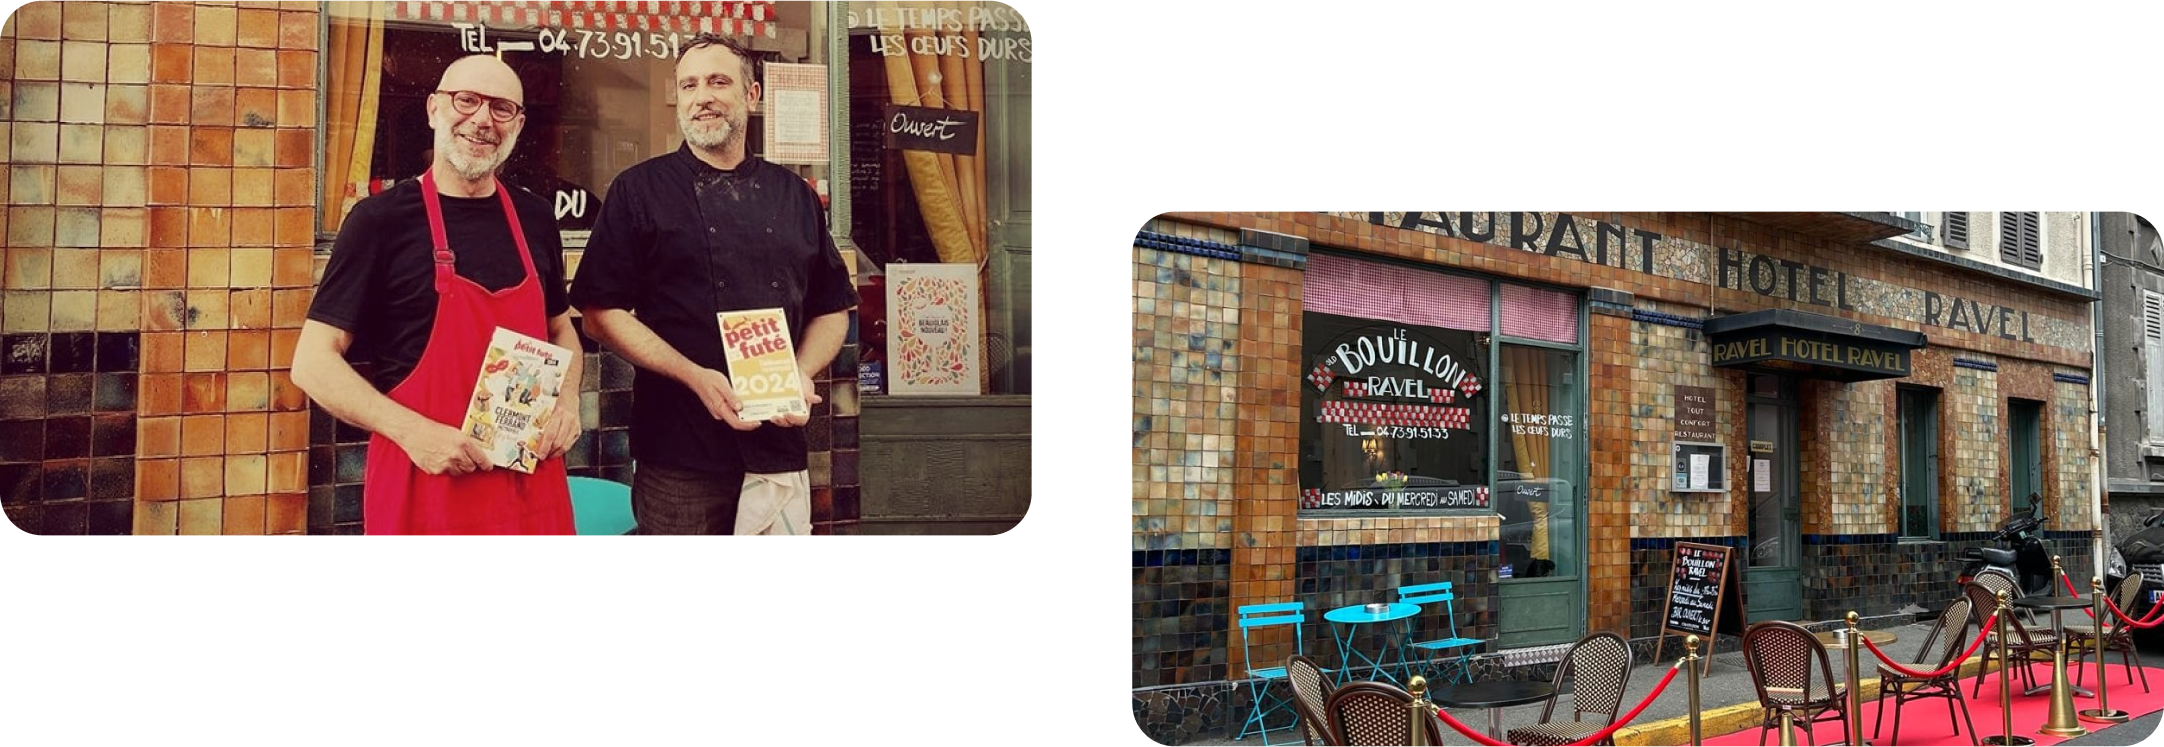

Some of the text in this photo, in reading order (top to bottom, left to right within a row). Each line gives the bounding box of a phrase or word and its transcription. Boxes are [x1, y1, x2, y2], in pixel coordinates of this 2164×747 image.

[867, 8, 888, 30] LE
[899, 8, 963, 32] TEMPS
[452, 23, 493, 52] TEL
[870, 35, 905, 56] LES
[978, 37, 1032, 63] DURS
[890, 113, 968, 141] Ouvert
[554, 188, 587, 220] DU
[1367, 211, 2034, 344] AURANT HOTEL RAVEL
[725, 317, 780, 348] petit
[1393, 328, 1407, 341] LE
[1854, 323, 1861, 336] 8
[739, 334, 787, 360] futé
[1714, 336, 1905, 373] RAVEL HOTEL RAVEL
[1336, 336, 1466, 389] BOUILLON
[735, 371, 800, 396] 2024
[1368, 376, 1430, 399] RAVEL
[1684, 395, 1706, 403] HOTEL
[1510, 413, 1573, 426] LE TEMPS PASSE
[1680, 419, 1711, 427] CONFORT
[1343, 424, 1359, 436] TEL
[1512, 425, 1526, 435] LES
[1551, 428, 1573, 439] DURS
[1674, 431, 1716, 439] RESTAURANT
[1321, 492, 1341, 506] LES
[1381, 492, 1395, 506] DU
[1694, 549, 1702, 557] LE
[1682, 556, 1715, 569] BOUILLON
[1688, 567, 1706, 577] RAVEL
